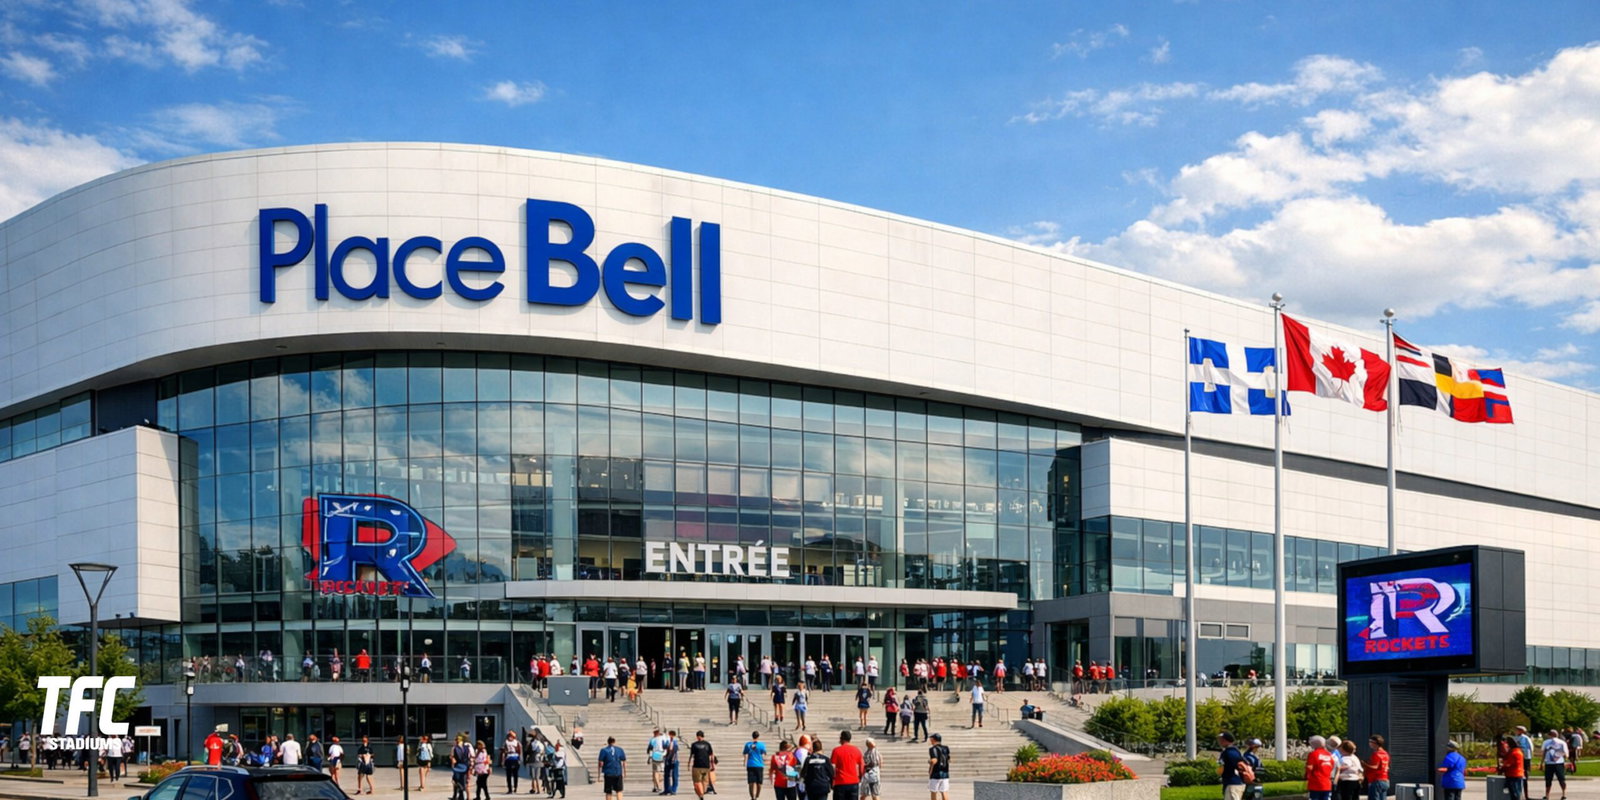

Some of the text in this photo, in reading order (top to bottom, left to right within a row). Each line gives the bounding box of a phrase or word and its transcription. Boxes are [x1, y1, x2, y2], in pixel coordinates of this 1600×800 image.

[258, 198, 722, 326] Place Bell
[645, 540, 791, 578] ENTRÉE
[1364, 635, 1450, 653] ROCKETS
